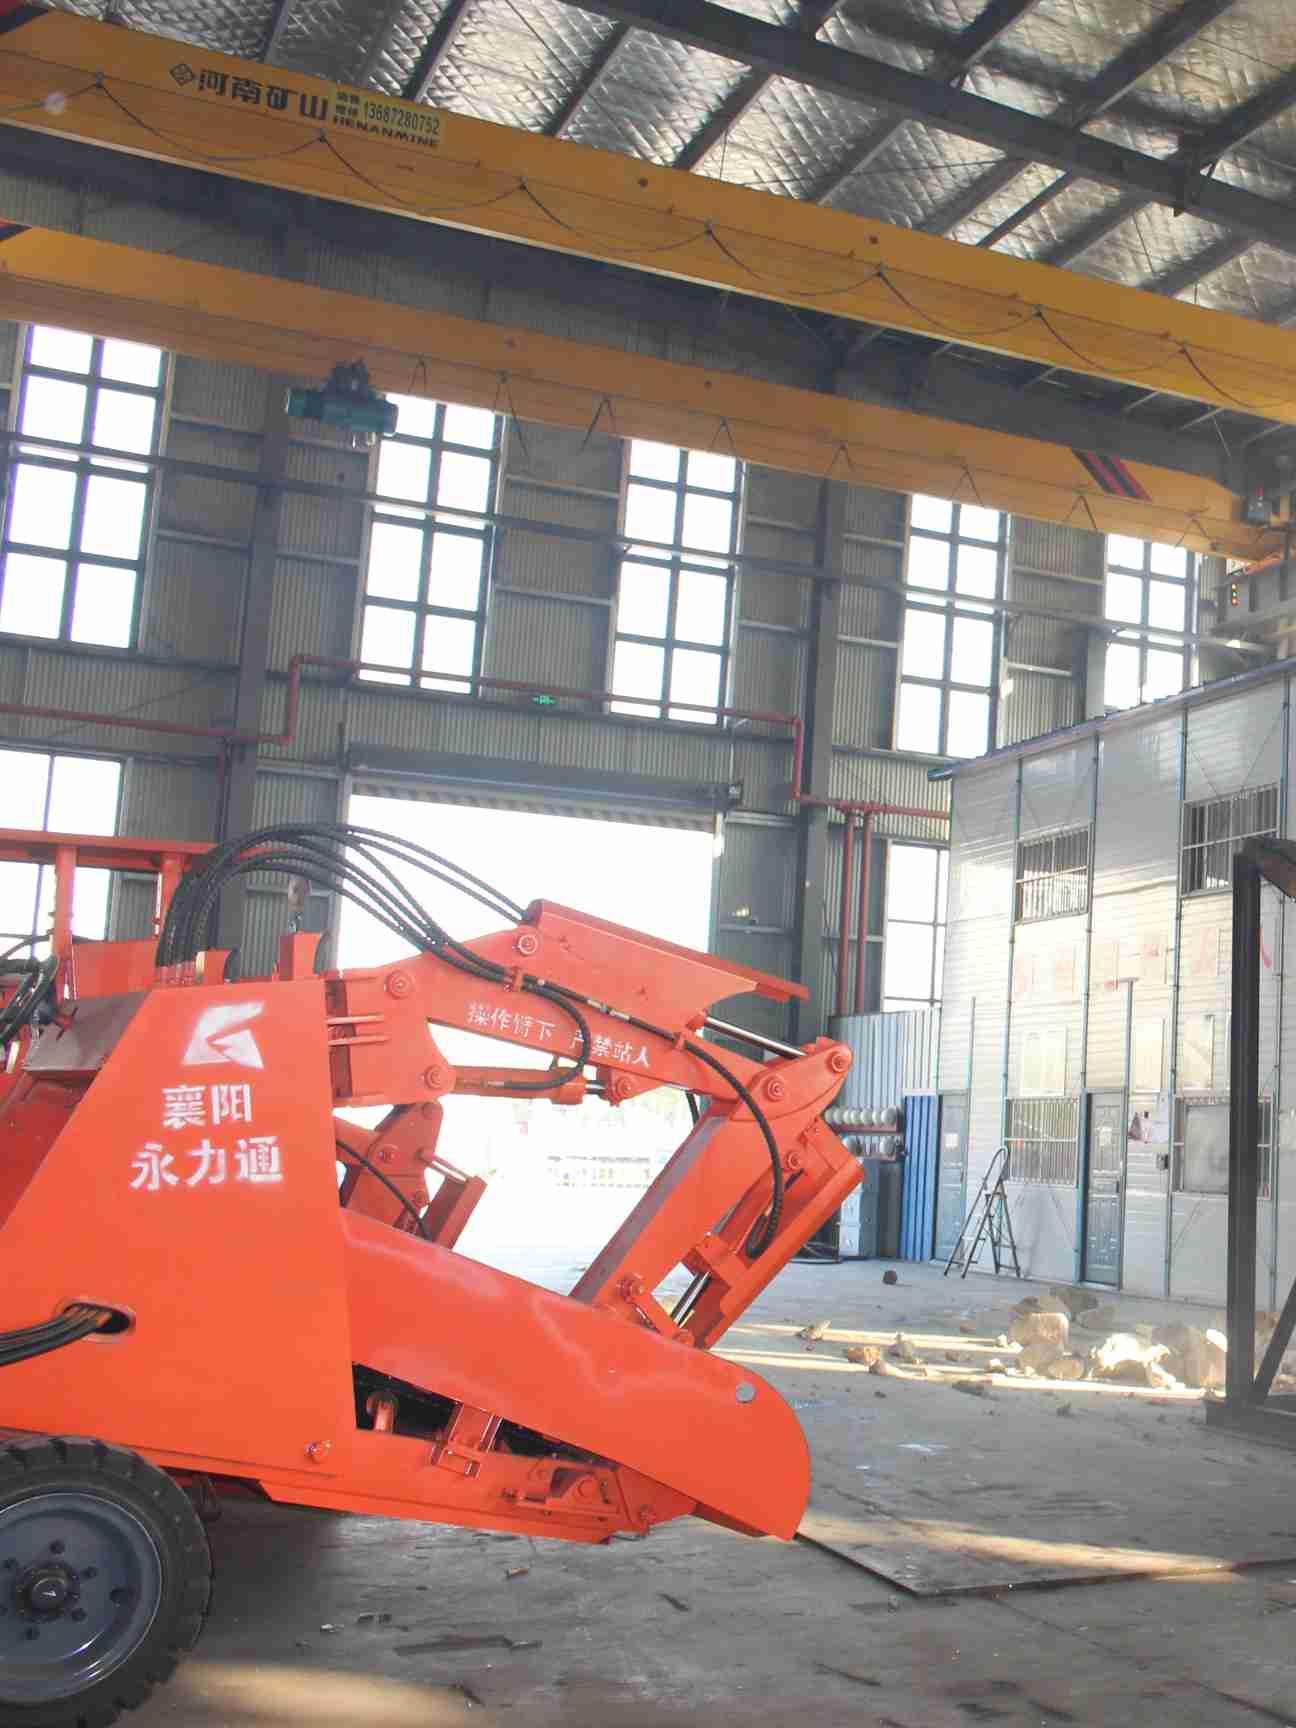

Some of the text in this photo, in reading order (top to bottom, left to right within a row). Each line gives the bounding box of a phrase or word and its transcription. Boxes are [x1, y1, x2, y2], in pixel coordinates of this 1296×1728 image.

[198, 68, 328, 121] 河南矿山
[161, 1083, 253, 1130] 襄阳
[130, 1135, 284, 1191] 永力通
